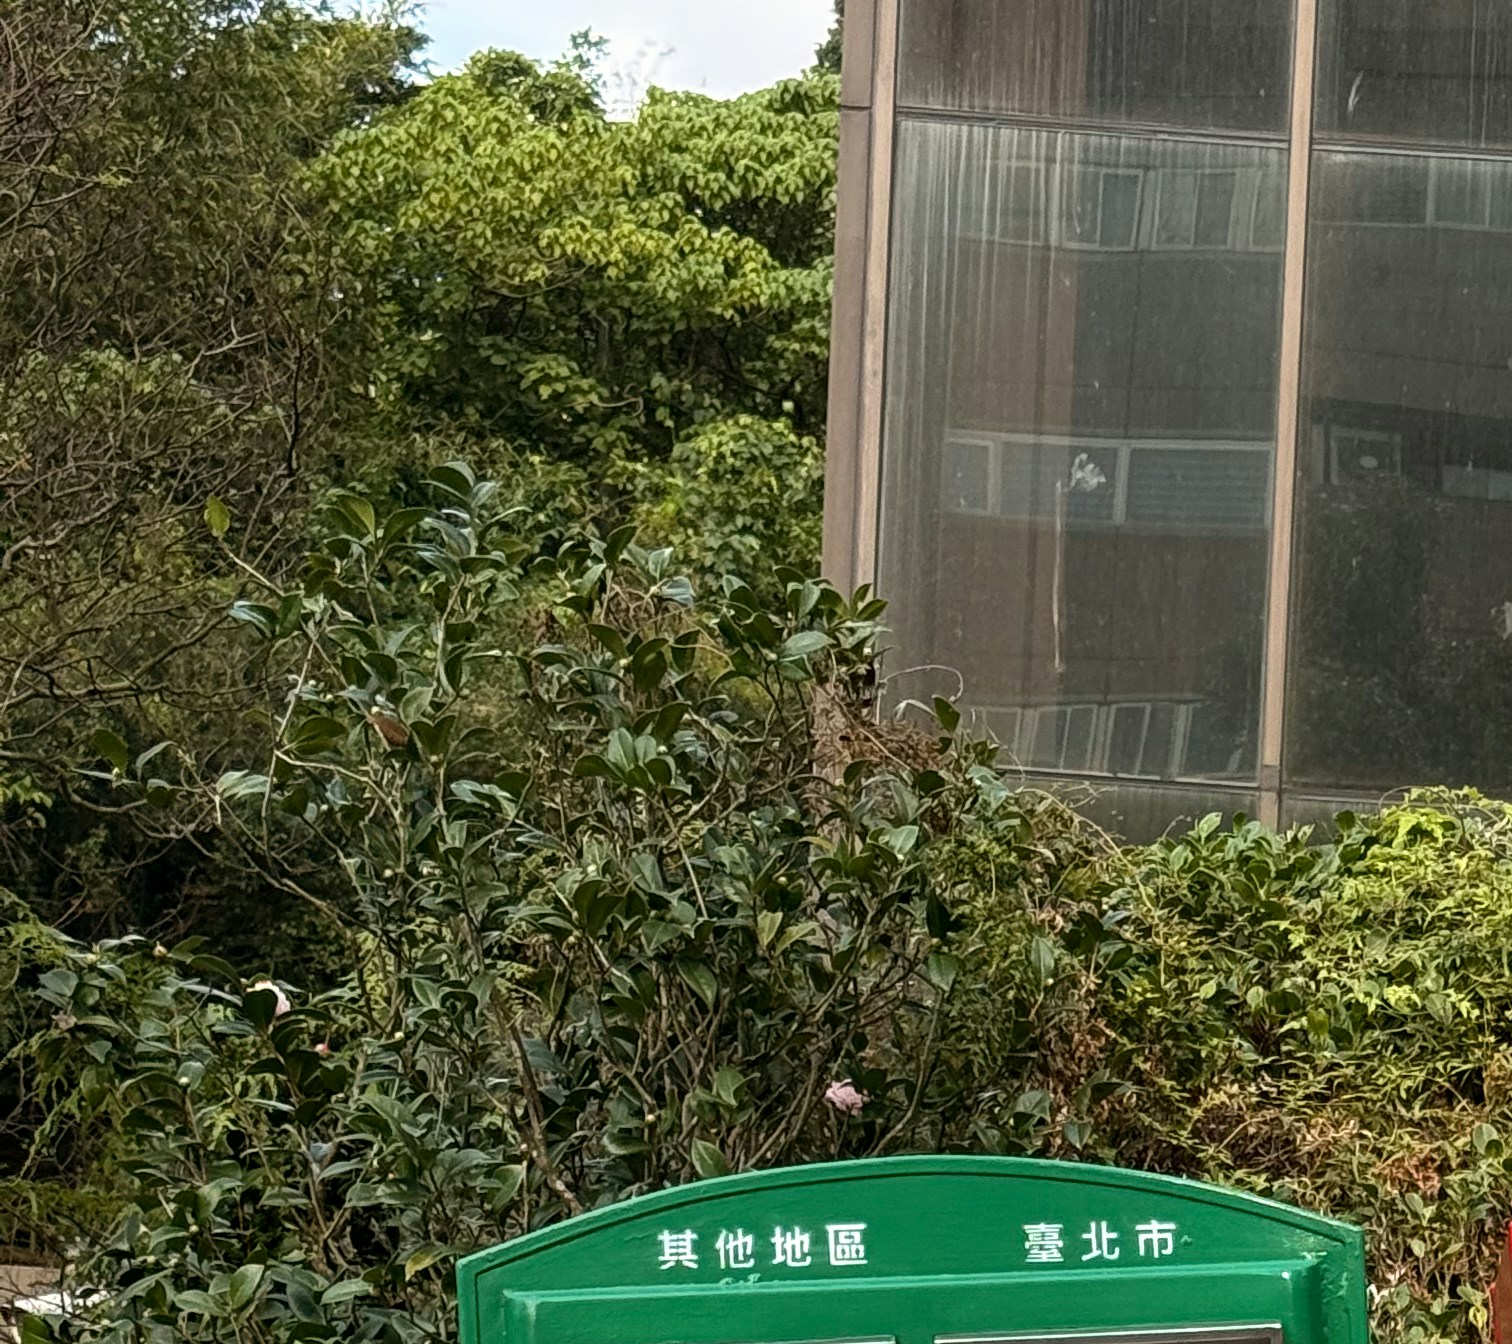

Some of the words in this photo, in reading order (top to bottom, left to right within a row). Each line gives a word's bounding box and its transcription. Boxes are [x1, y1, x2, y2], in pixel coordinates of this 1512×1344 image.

[657, 1222, 868, 1270] 其他地區
[1023, 1219, 1177, 1263] 臺北市
